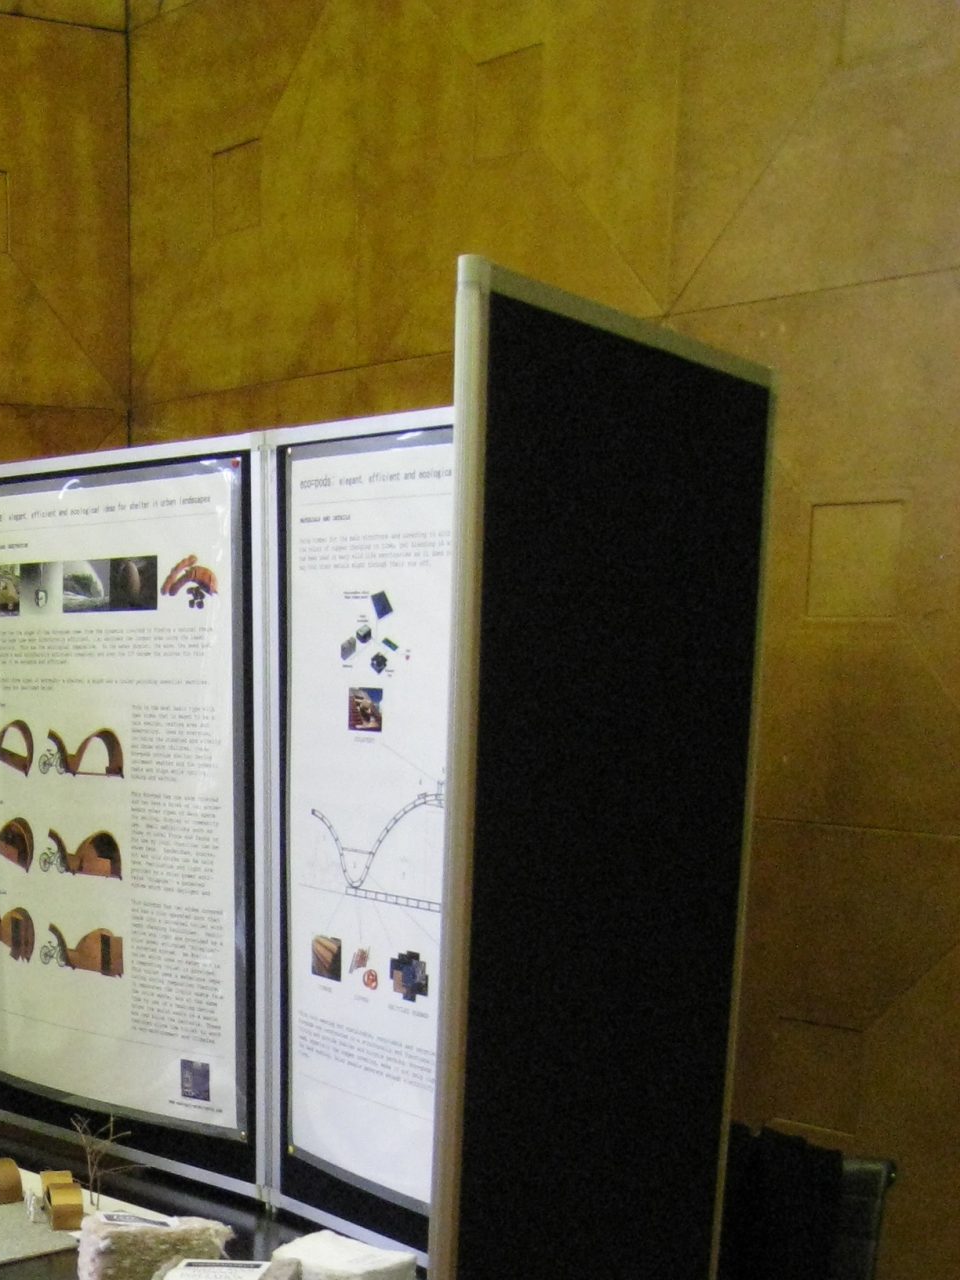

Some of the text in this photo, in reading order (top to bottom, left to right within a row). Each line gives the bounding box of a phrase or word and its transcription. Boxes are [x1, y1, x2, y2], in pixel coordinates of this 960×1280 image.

[368, 470, 401, 484] efficient
[403, 468, 416, 480] and
[418, 466, 453, 480] ecologica
[58, 507, 68, 517] and
[118, 502, 127, 512] for
[129, 499, 150, 511] shelter
[160, 497, 177, 508] urban
[178, 494, 212, 507] landscapes
